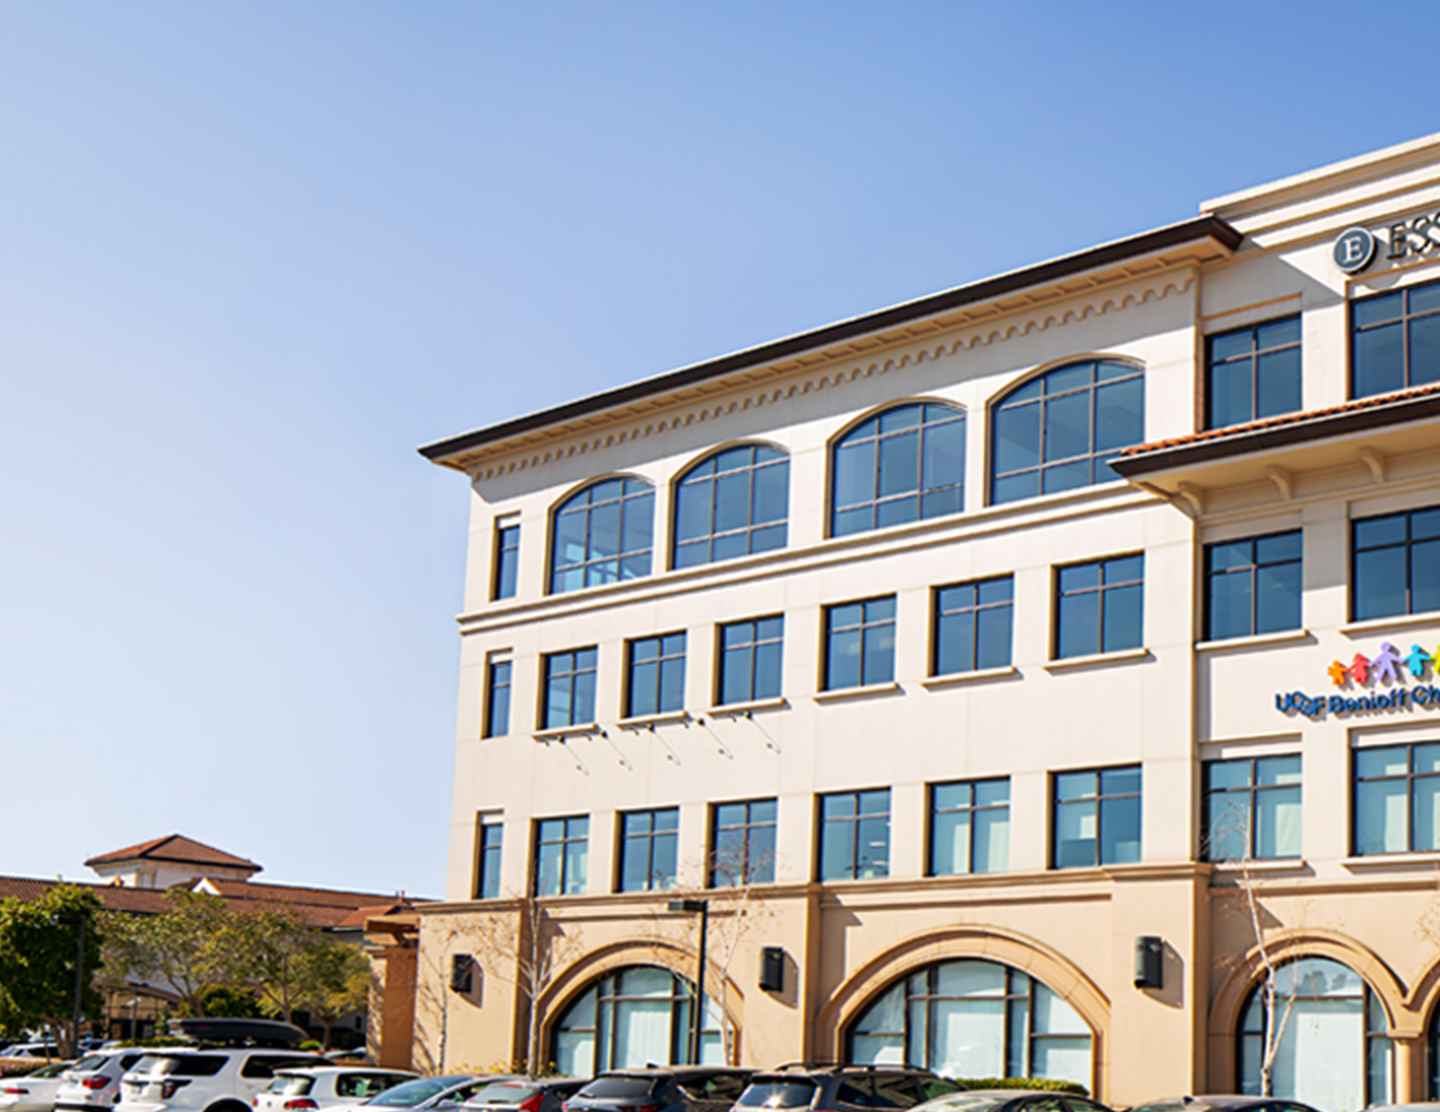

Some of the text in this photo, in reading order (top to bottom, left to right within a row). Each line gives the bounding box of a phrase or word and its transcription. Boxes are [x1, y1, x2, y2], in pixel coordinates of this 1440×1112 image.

[1343, 236, 1364, 264] E
[1275, 690, 1327, 716] UCSF
[1328, 687, 1406, 713] Benioff
